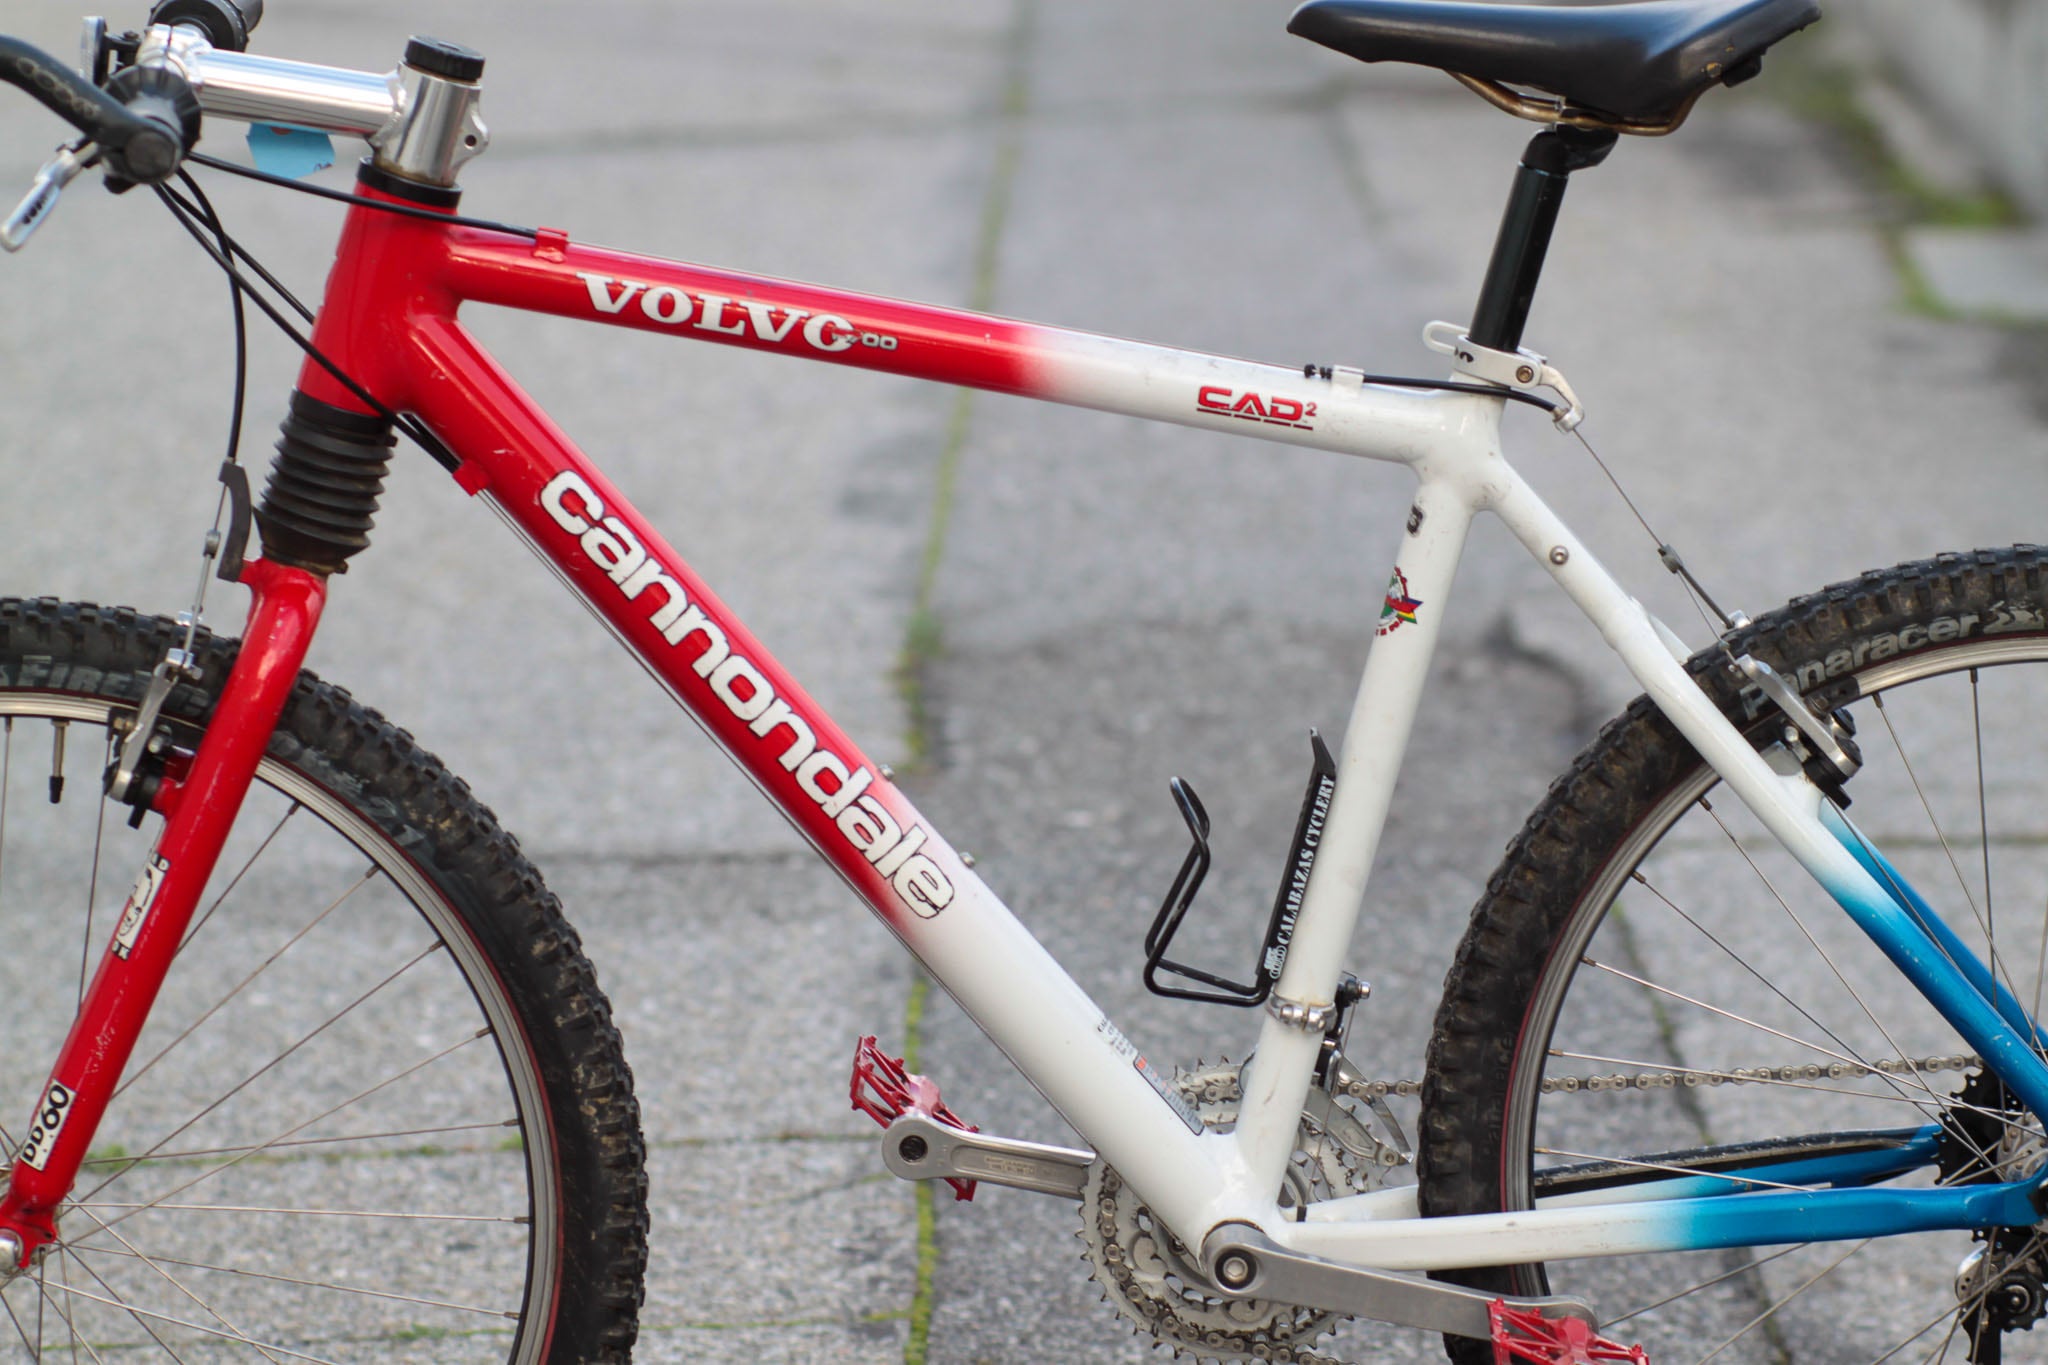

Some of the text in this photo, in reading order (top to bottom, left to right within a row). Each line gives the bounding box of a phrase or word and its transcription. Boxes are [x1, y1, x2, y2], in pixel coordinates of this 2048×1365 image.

[540, 469, 956, 920] cannondale
[1276, 774, 1336, 946] CALABAZAS CYCLERY
